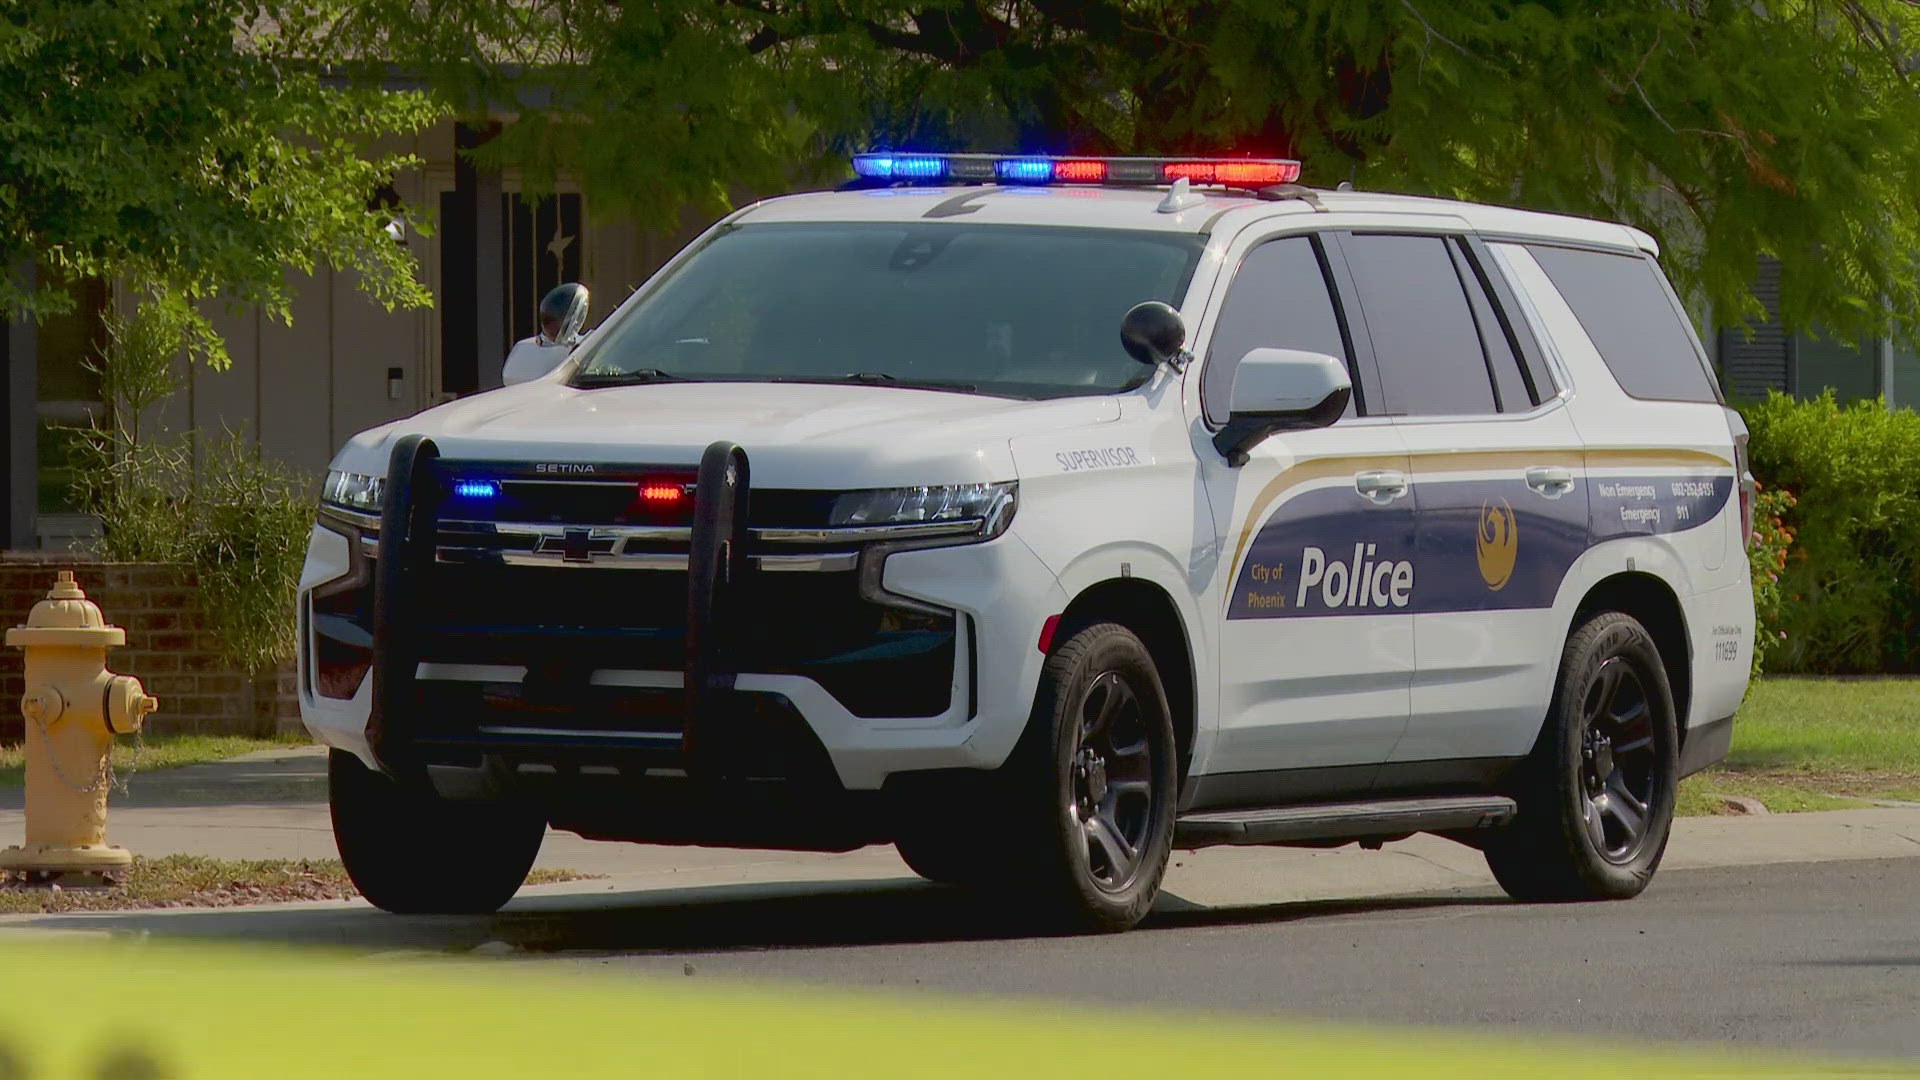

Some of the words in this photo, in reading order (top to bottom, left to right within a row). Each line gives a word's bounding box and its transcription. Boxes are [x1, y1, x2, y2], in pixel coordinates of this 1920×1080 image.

[535, 463, 595, 473] SETINA
[1055, 446, 1140, 472] SUPERVISOR
[1598, 482, 1616, 498] Non
[1615, 482, 1656, 500] Emergency
[1620, 506, 1660, 524] Emergency
[1676, 504, 1690, 520] 911
[1251, 563, 1270, 583] City
[1272, 562, 1283, 580] of
[1295, 542, 1414, 608] Police
[1248, 591, 1286, 608] Phoenix
[1715, 640, 1738, 662] 111699
